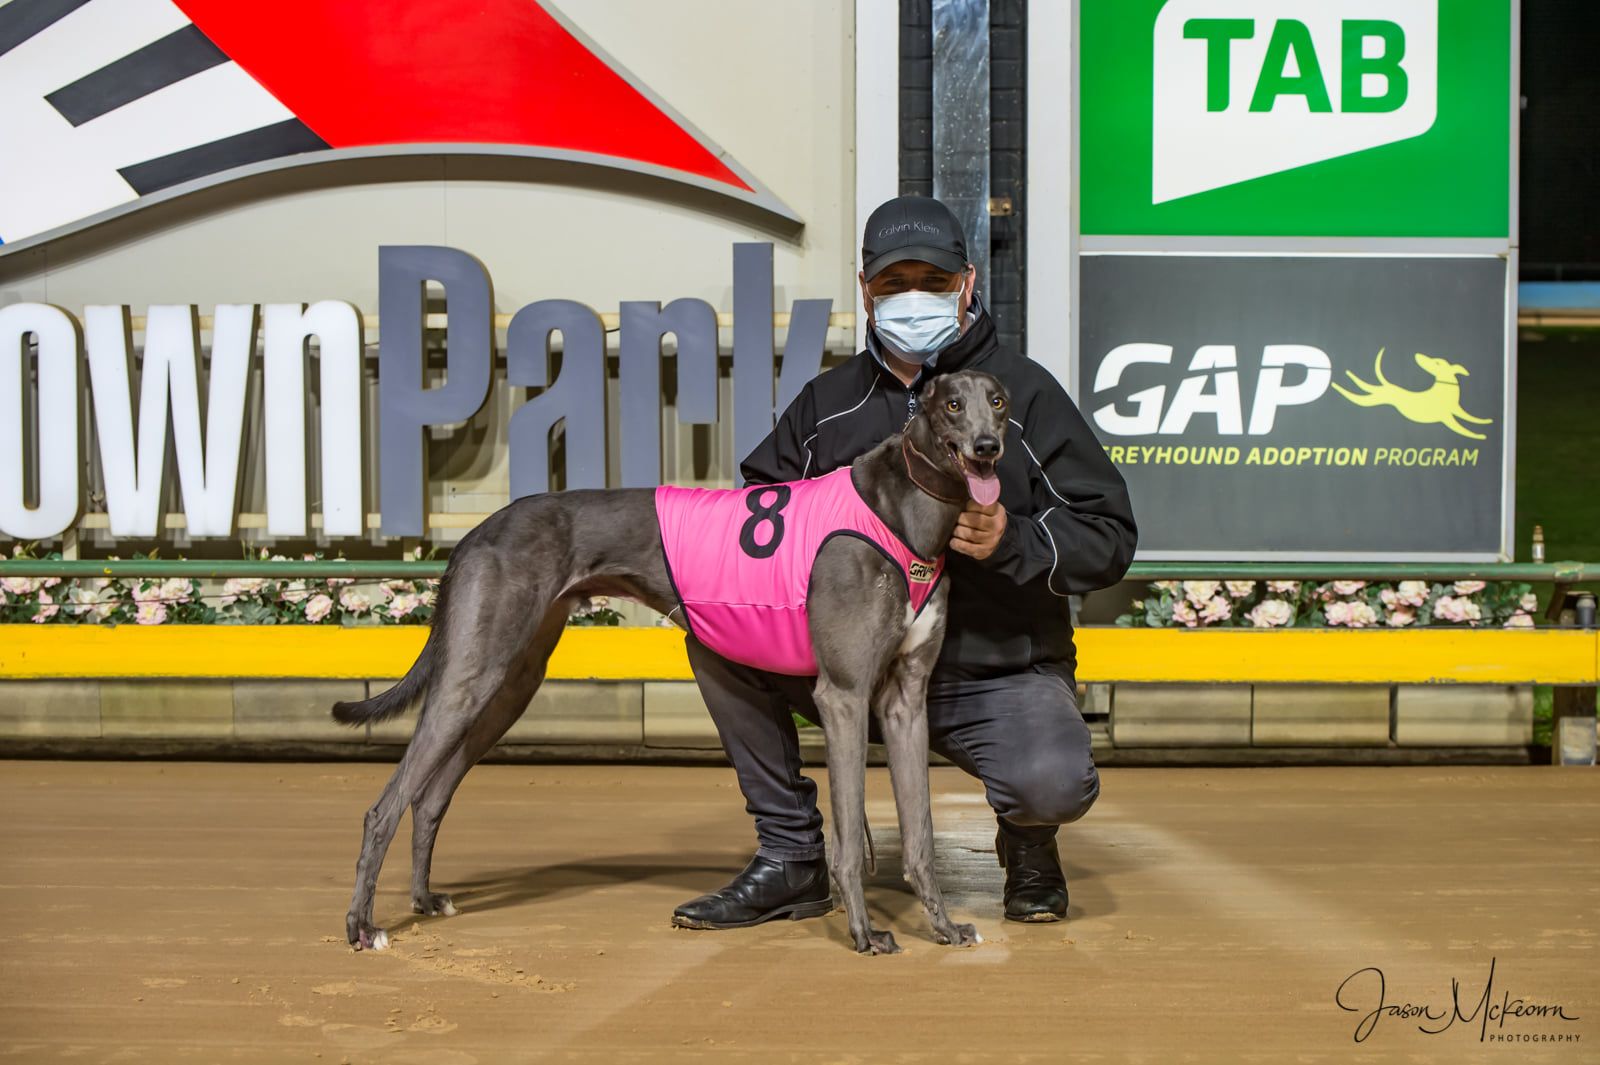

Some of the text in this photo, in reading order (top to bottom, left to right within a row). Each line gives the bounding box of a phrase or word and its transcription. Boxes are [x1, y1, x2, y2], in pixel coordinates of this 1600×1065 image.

[1183, 18, 1409, 114] TAB
[879, 220, 941, 239] Calvin Klein
[1093, 342, 1332, 436] GAP
[1102, 445, 1480, 467] REYHOUND ADOPTION PROGRAM
[739, 484, 792, 559] 8
